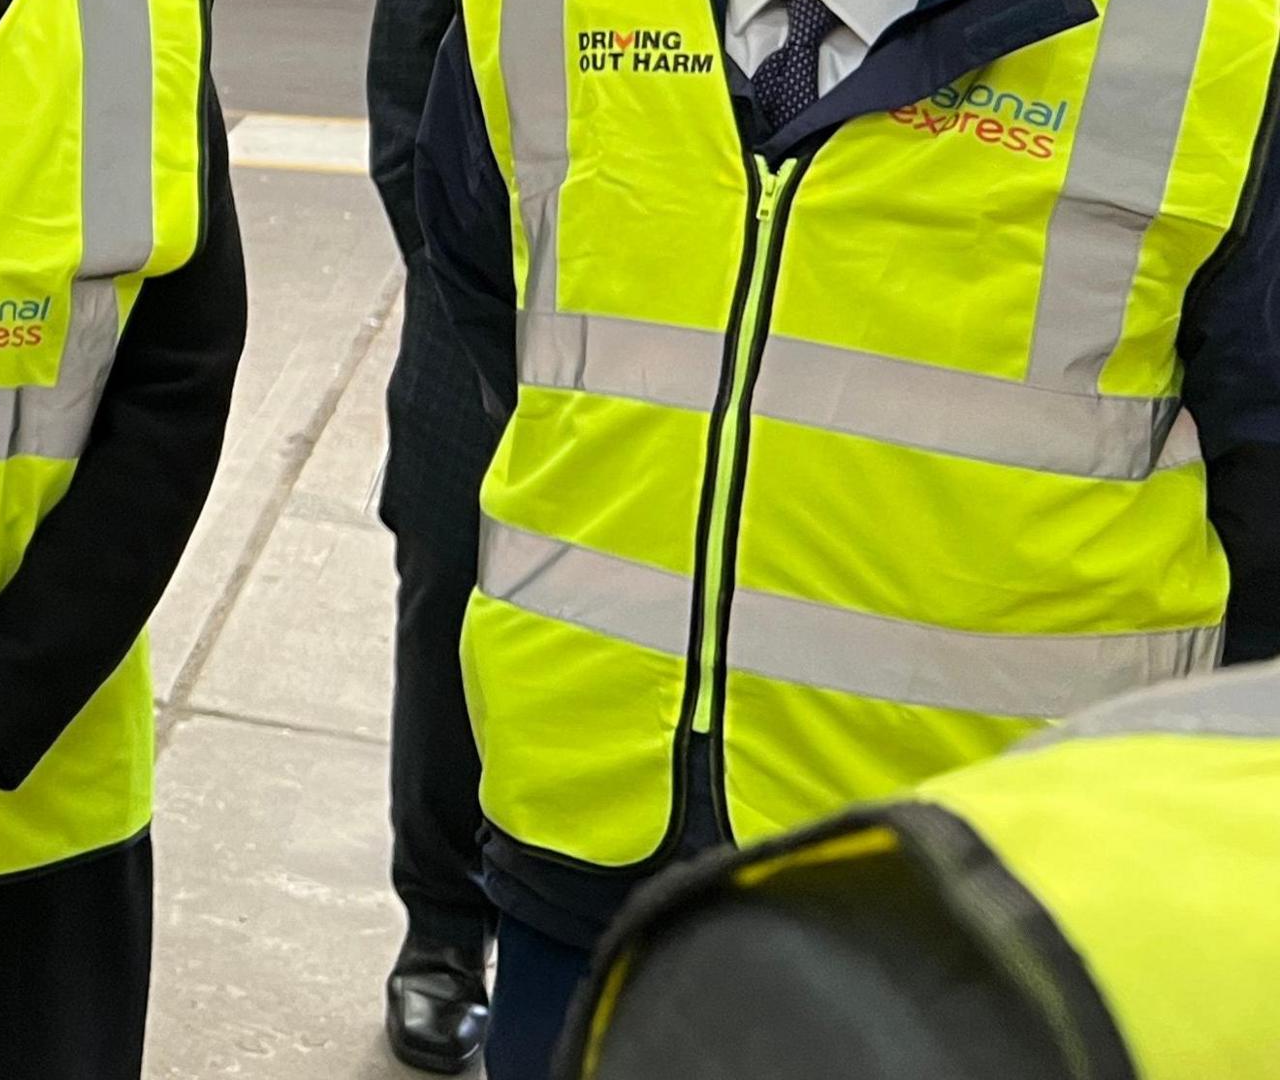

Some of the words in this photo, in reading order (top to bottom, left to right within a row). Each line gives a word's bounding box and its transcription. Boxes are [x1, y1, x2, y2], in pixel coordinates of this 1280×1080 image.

[578, 30, 682, 51] DRIVING
[579, 52, 624, 73] OUT
[632, 52, 714, 74] HARM
